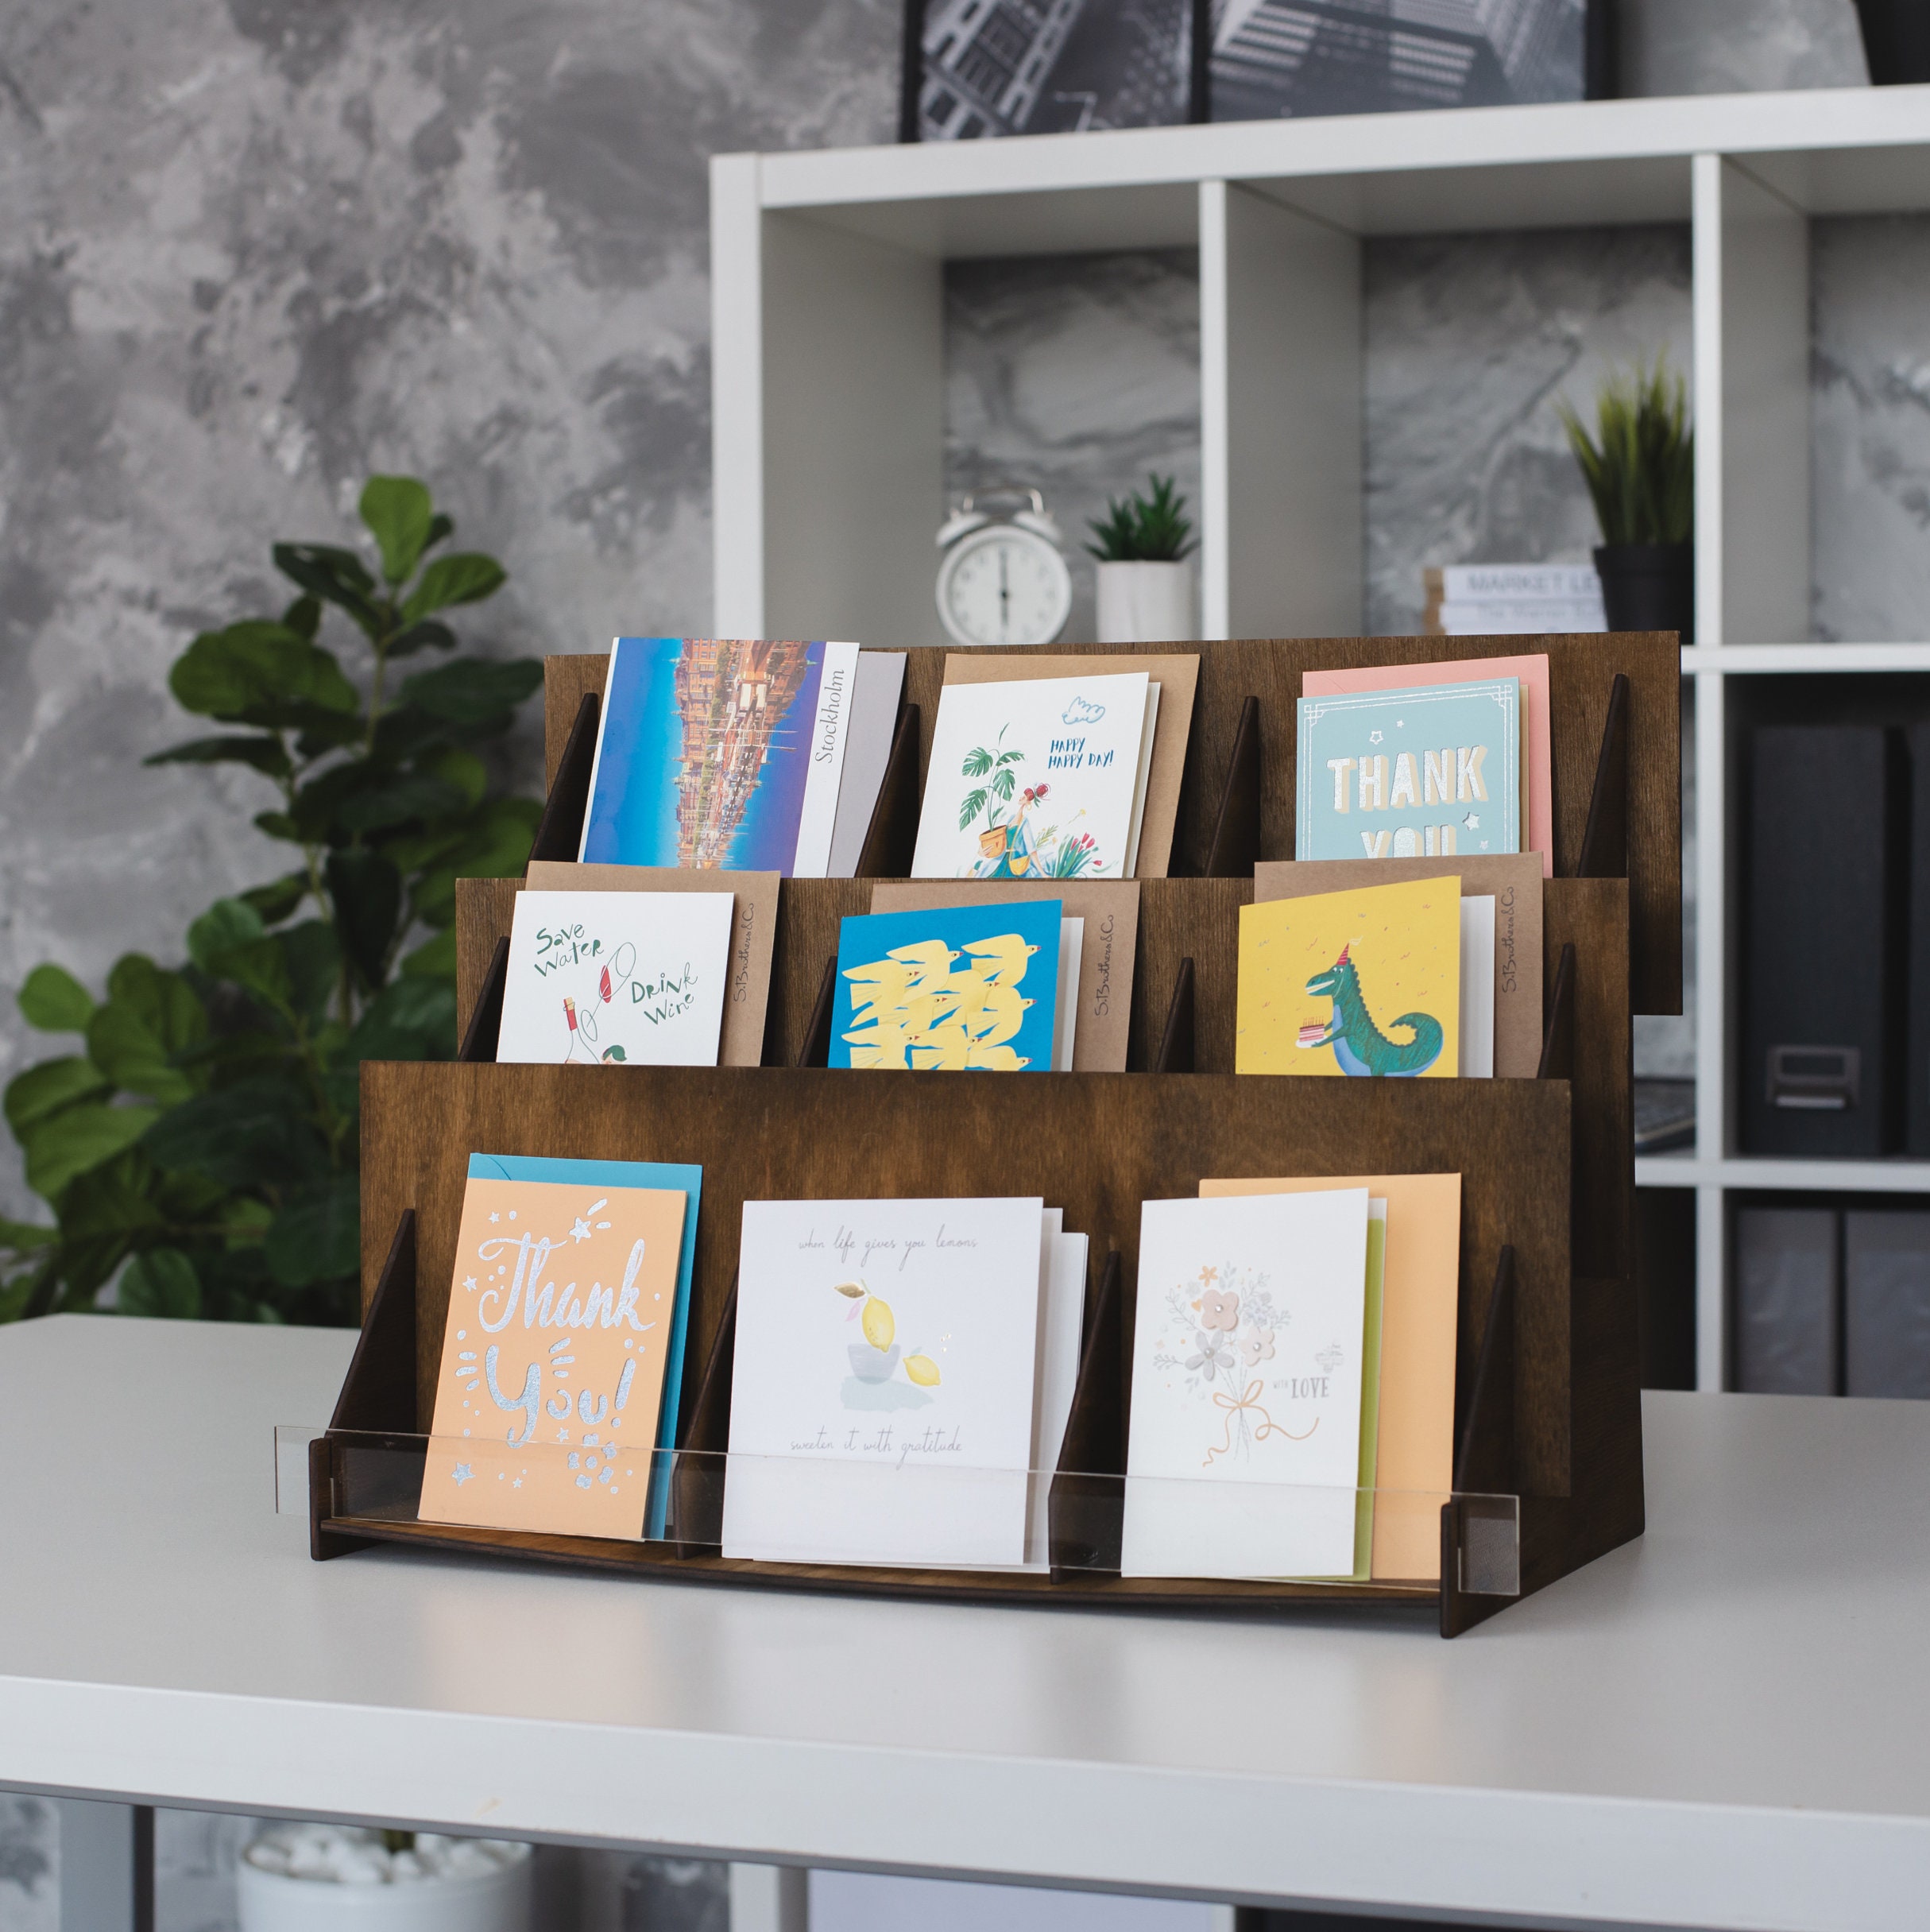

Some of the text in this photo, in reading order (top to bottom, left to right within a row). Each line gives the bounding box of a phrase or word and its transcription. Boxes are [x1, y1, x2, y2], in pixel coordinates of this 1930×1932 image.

[1468, 571, 1561, 592] MARKET
[814, 669, 845, 764] Stockholm
[1047, 749, 1114, 769] HAPPY DAY!
[1050, 737, 1085, 753] HAPPY
[1326, 745, 1489, 815] THANK
[536, 923, 585, 955] Save
[644, 993, 694, 1025] Wine
[799, 1223, 978, 1272] when life gives you lemons
[478, 1231, 656, 1334] Thank
[485, 1345, 636, 1450] You!
[1291, 1376, 1330, 1399] LOVE
[790, 1424, 963, 1471] sweeten it with gratitude
